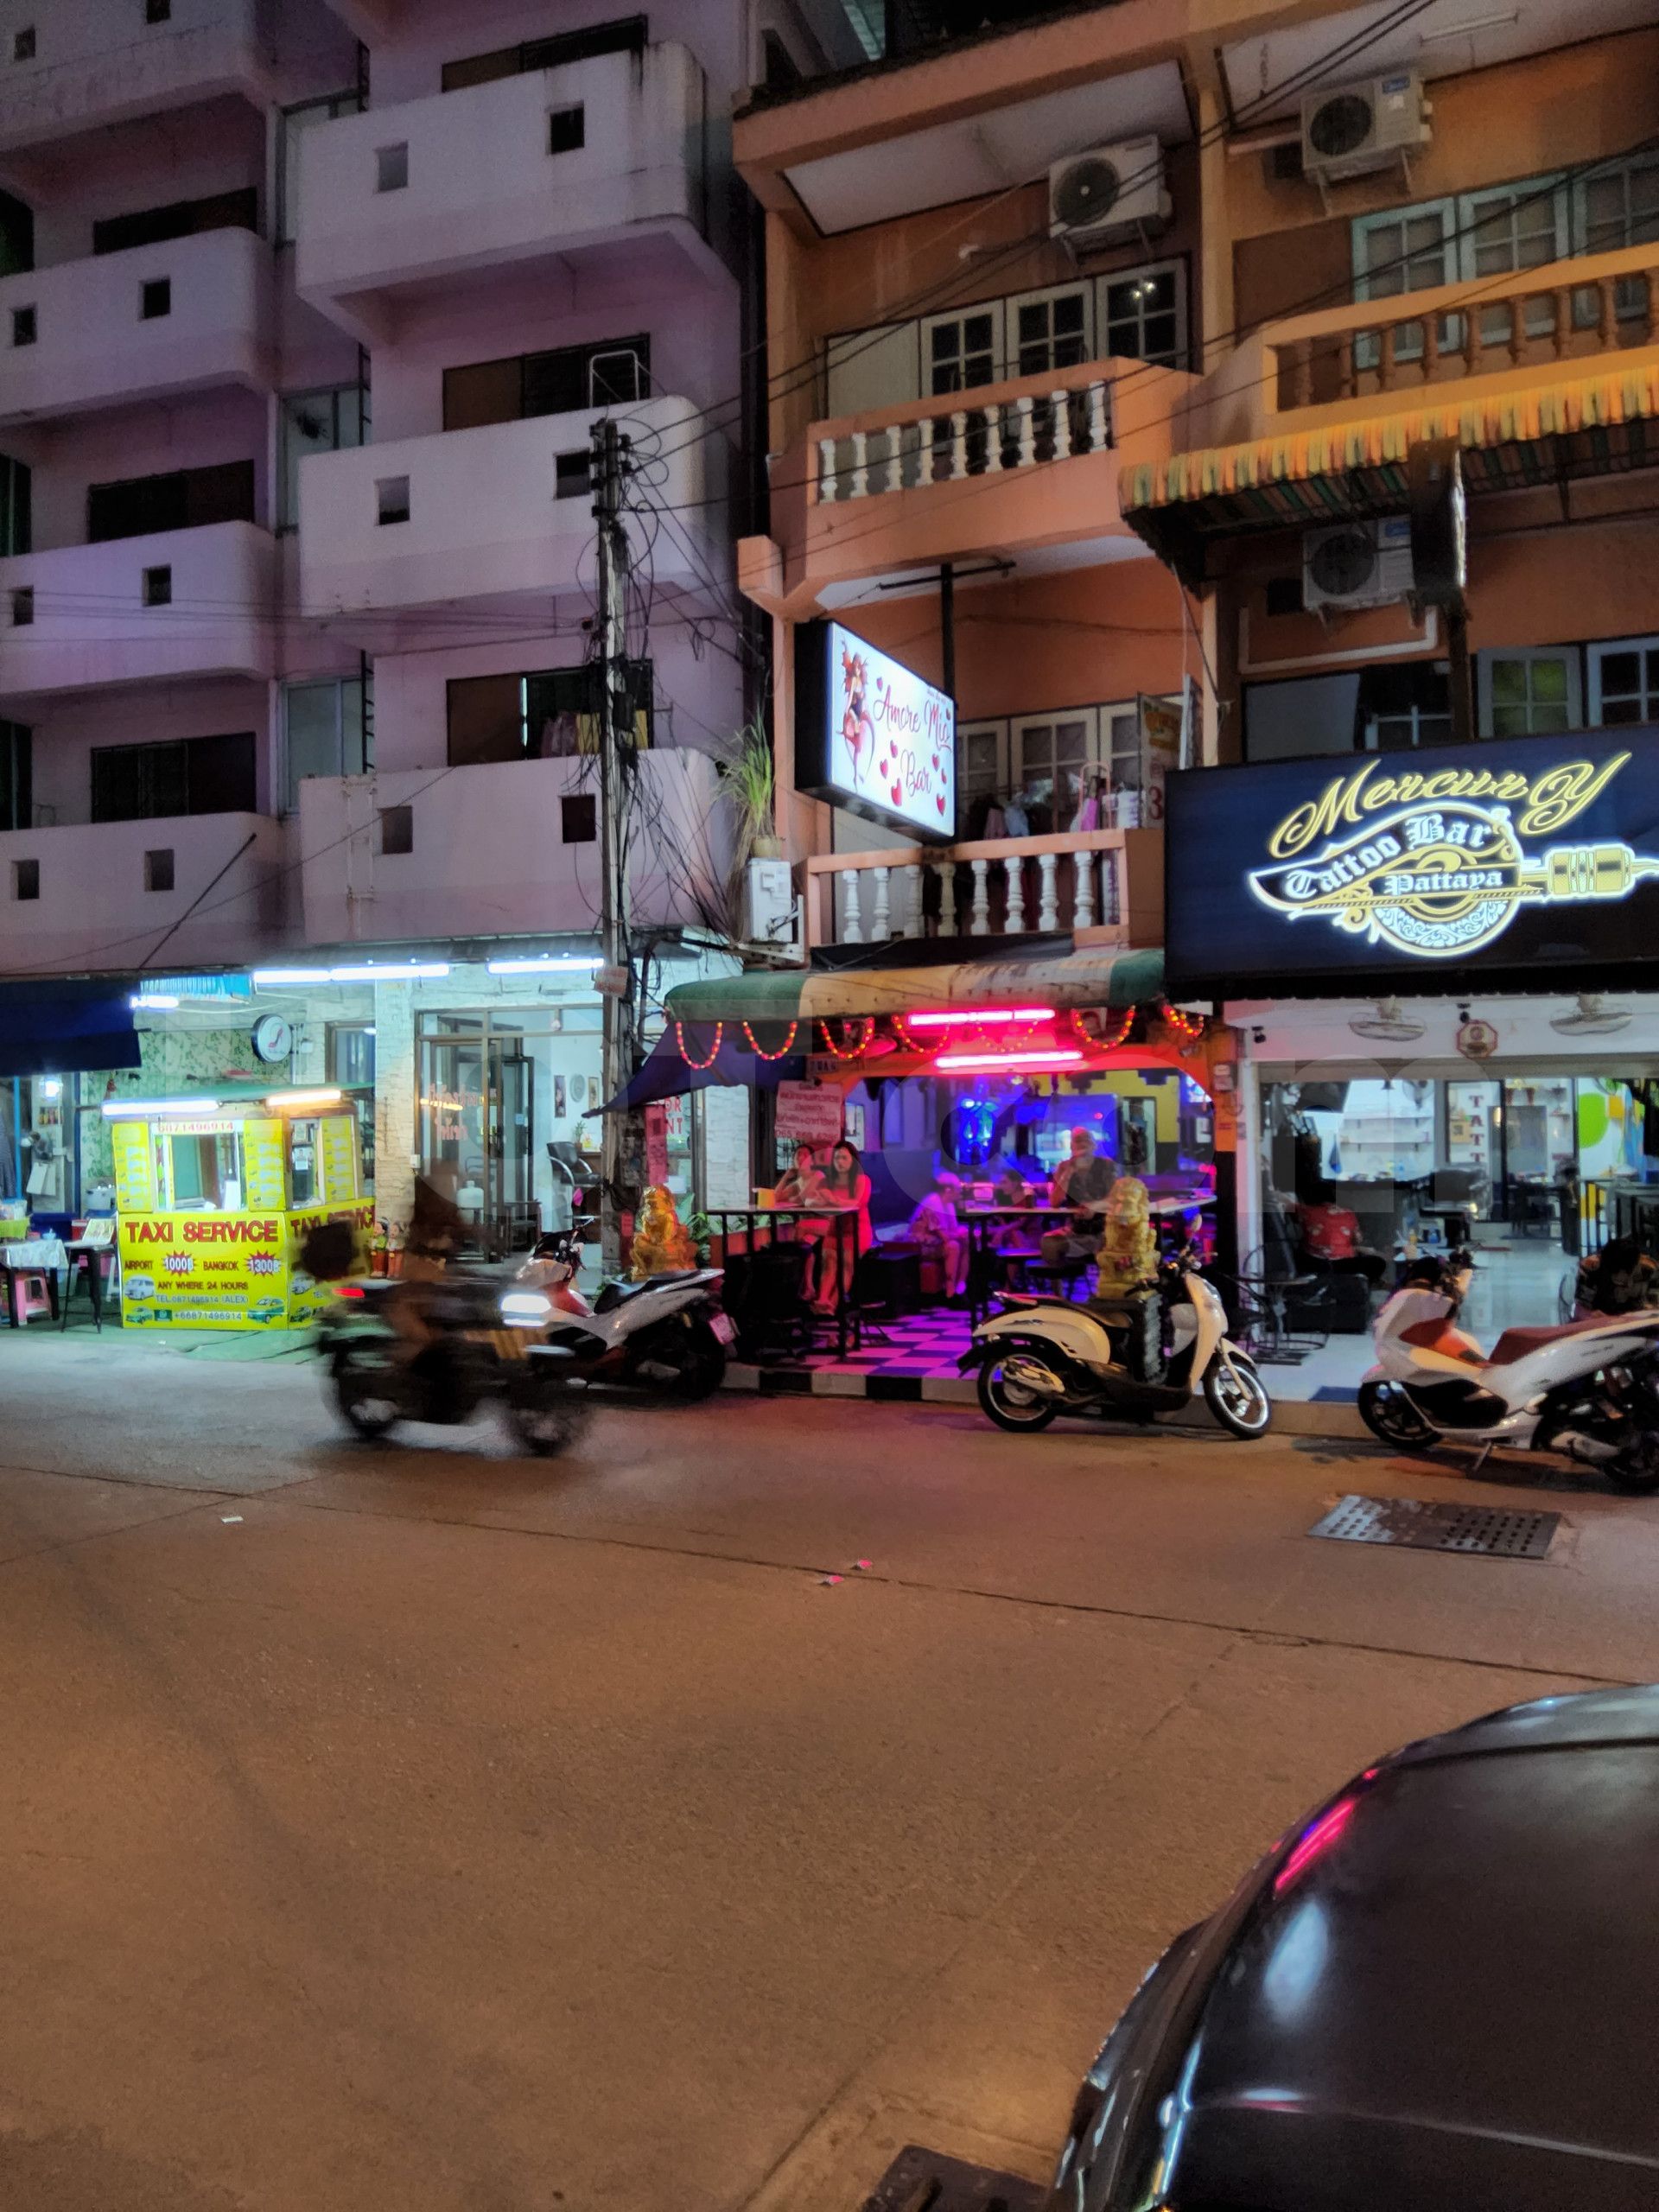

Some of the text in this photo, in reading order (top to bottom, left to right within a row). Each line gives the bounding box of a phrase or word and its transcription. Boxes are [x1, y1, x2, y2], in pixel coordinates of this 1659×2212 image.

[874, 684, 953, 753] Amore Mio
[900, 749, 931, 798] Bar
[1285, 814, 1492, 899] Tattoo Bar
[1382, 868, 1503, 896] Pattaya
[664, 1096, 682, 1112] OR
[125, 1221, 278, 1243] TAXI SERVICE
[124, 1260, 153, 1270] AIRPORT
[203, 1261, 238, 1271] BANGKOK
[158, 1281, 171, 1290] ANY
[176, 1281, 203, 1290] WHERE
[221, 1281, 249, 1290] HOURS
